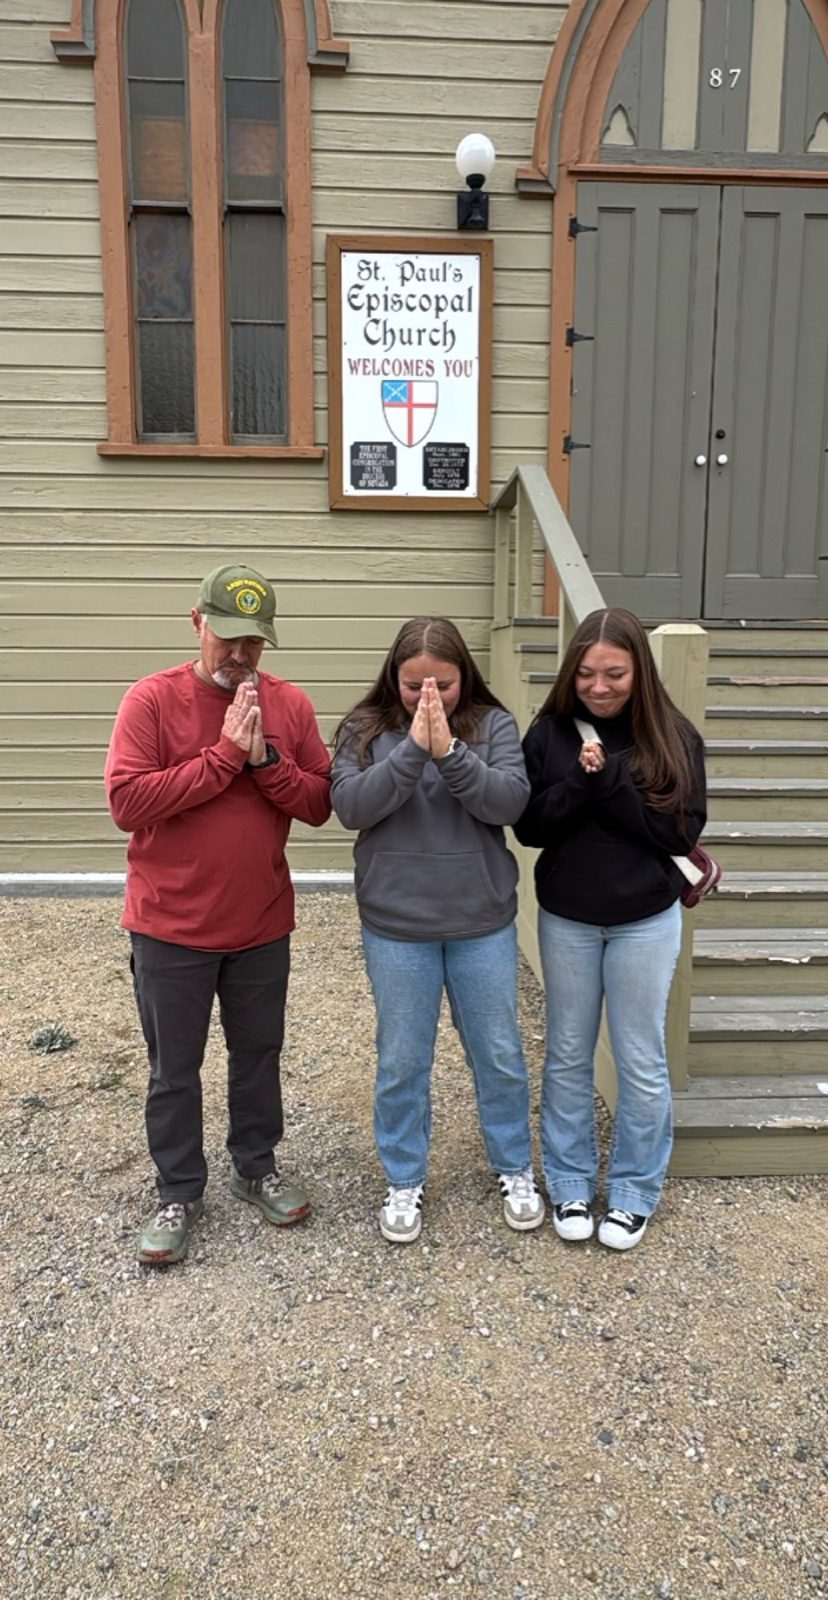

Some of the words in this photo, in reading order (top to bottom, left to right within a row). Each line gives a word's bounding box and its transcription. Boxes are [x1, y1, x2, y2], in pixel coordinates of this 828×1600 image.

[710, 67, 741, 88] 87
[357, 259, 386, 281] St.
[395, 260, 463, 287] Paul's
[347, 284, 473, 319] Episcopal
[363, 318, 456, 353] Church
[347, 358, 435, 377] WELCOMES
[444, 359, 473, 378] YOU
